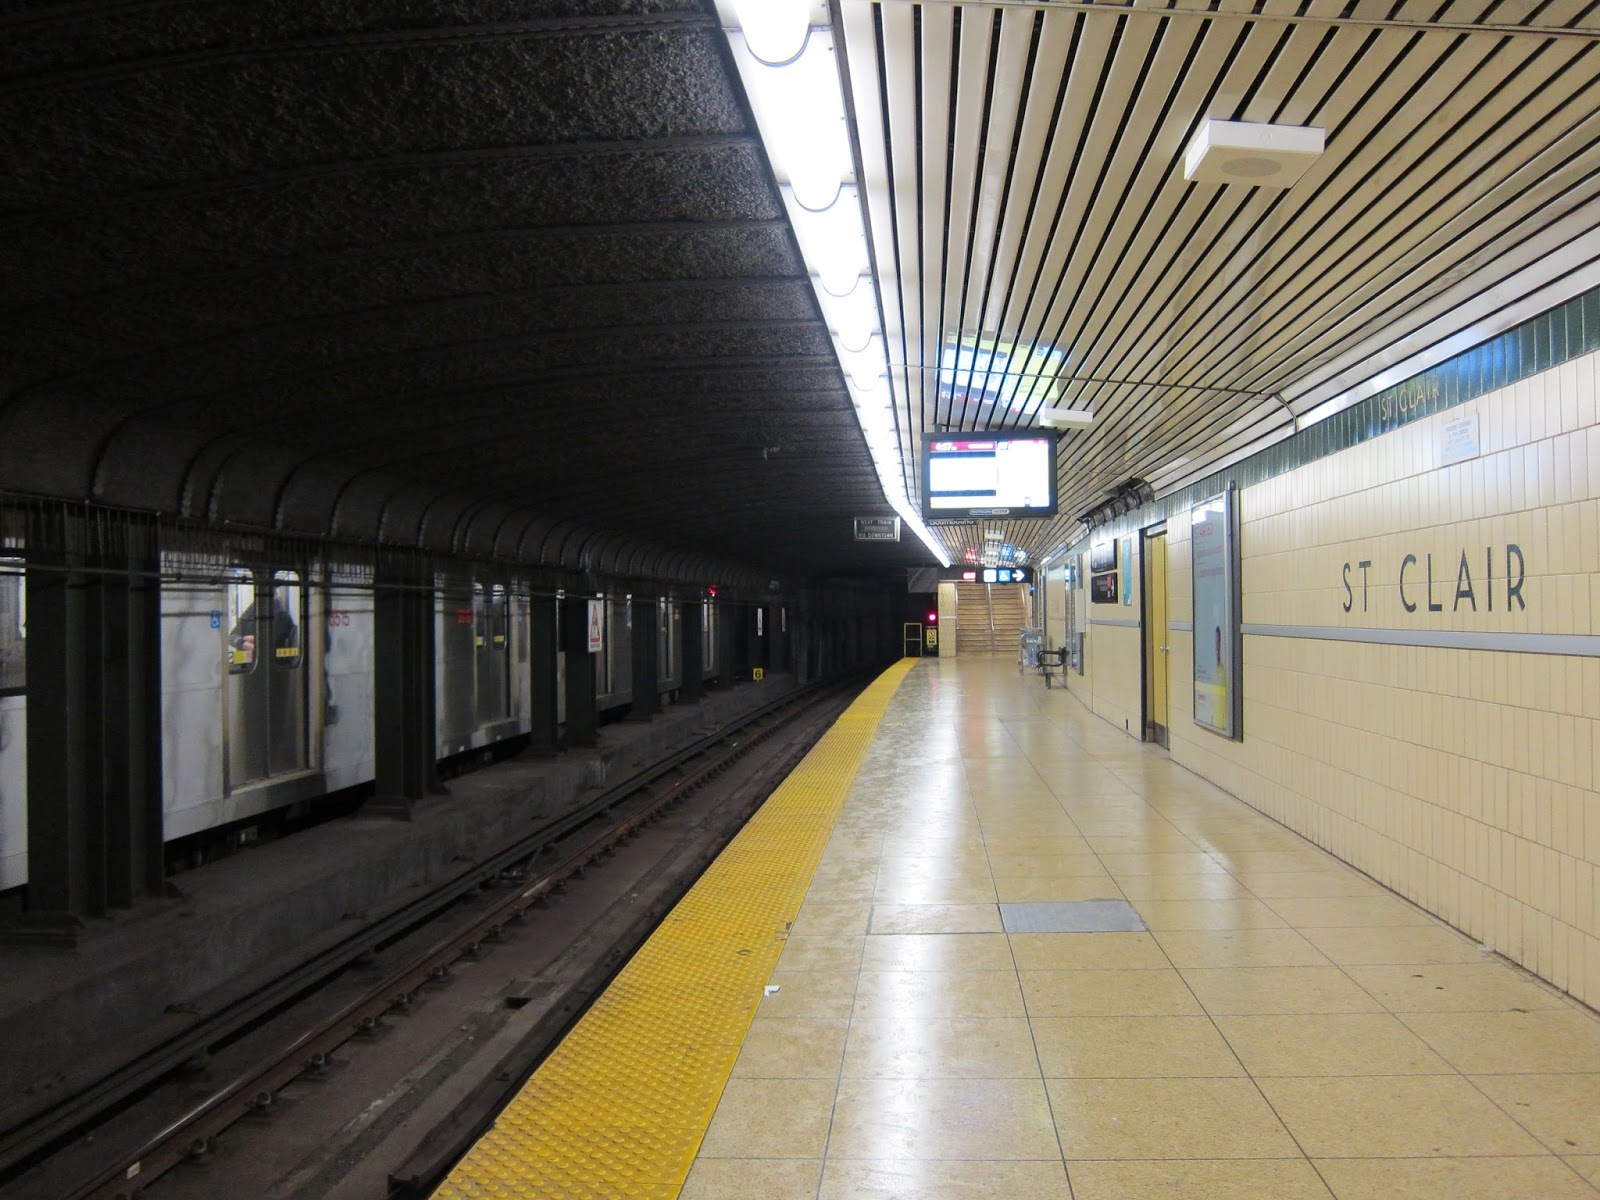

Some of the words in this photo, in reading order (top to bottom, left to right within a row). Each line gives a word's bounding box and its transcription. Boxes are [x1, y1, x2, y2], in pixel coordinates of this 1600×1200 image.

[1381, 395, 1393, 421] ST
[1399, 375, 1440, 412] CLAIR
[1343, 560, 1372, 613] ST
[1399, 543, 1526, 613] CLAIR
[755, 669, 761, 679] 6
